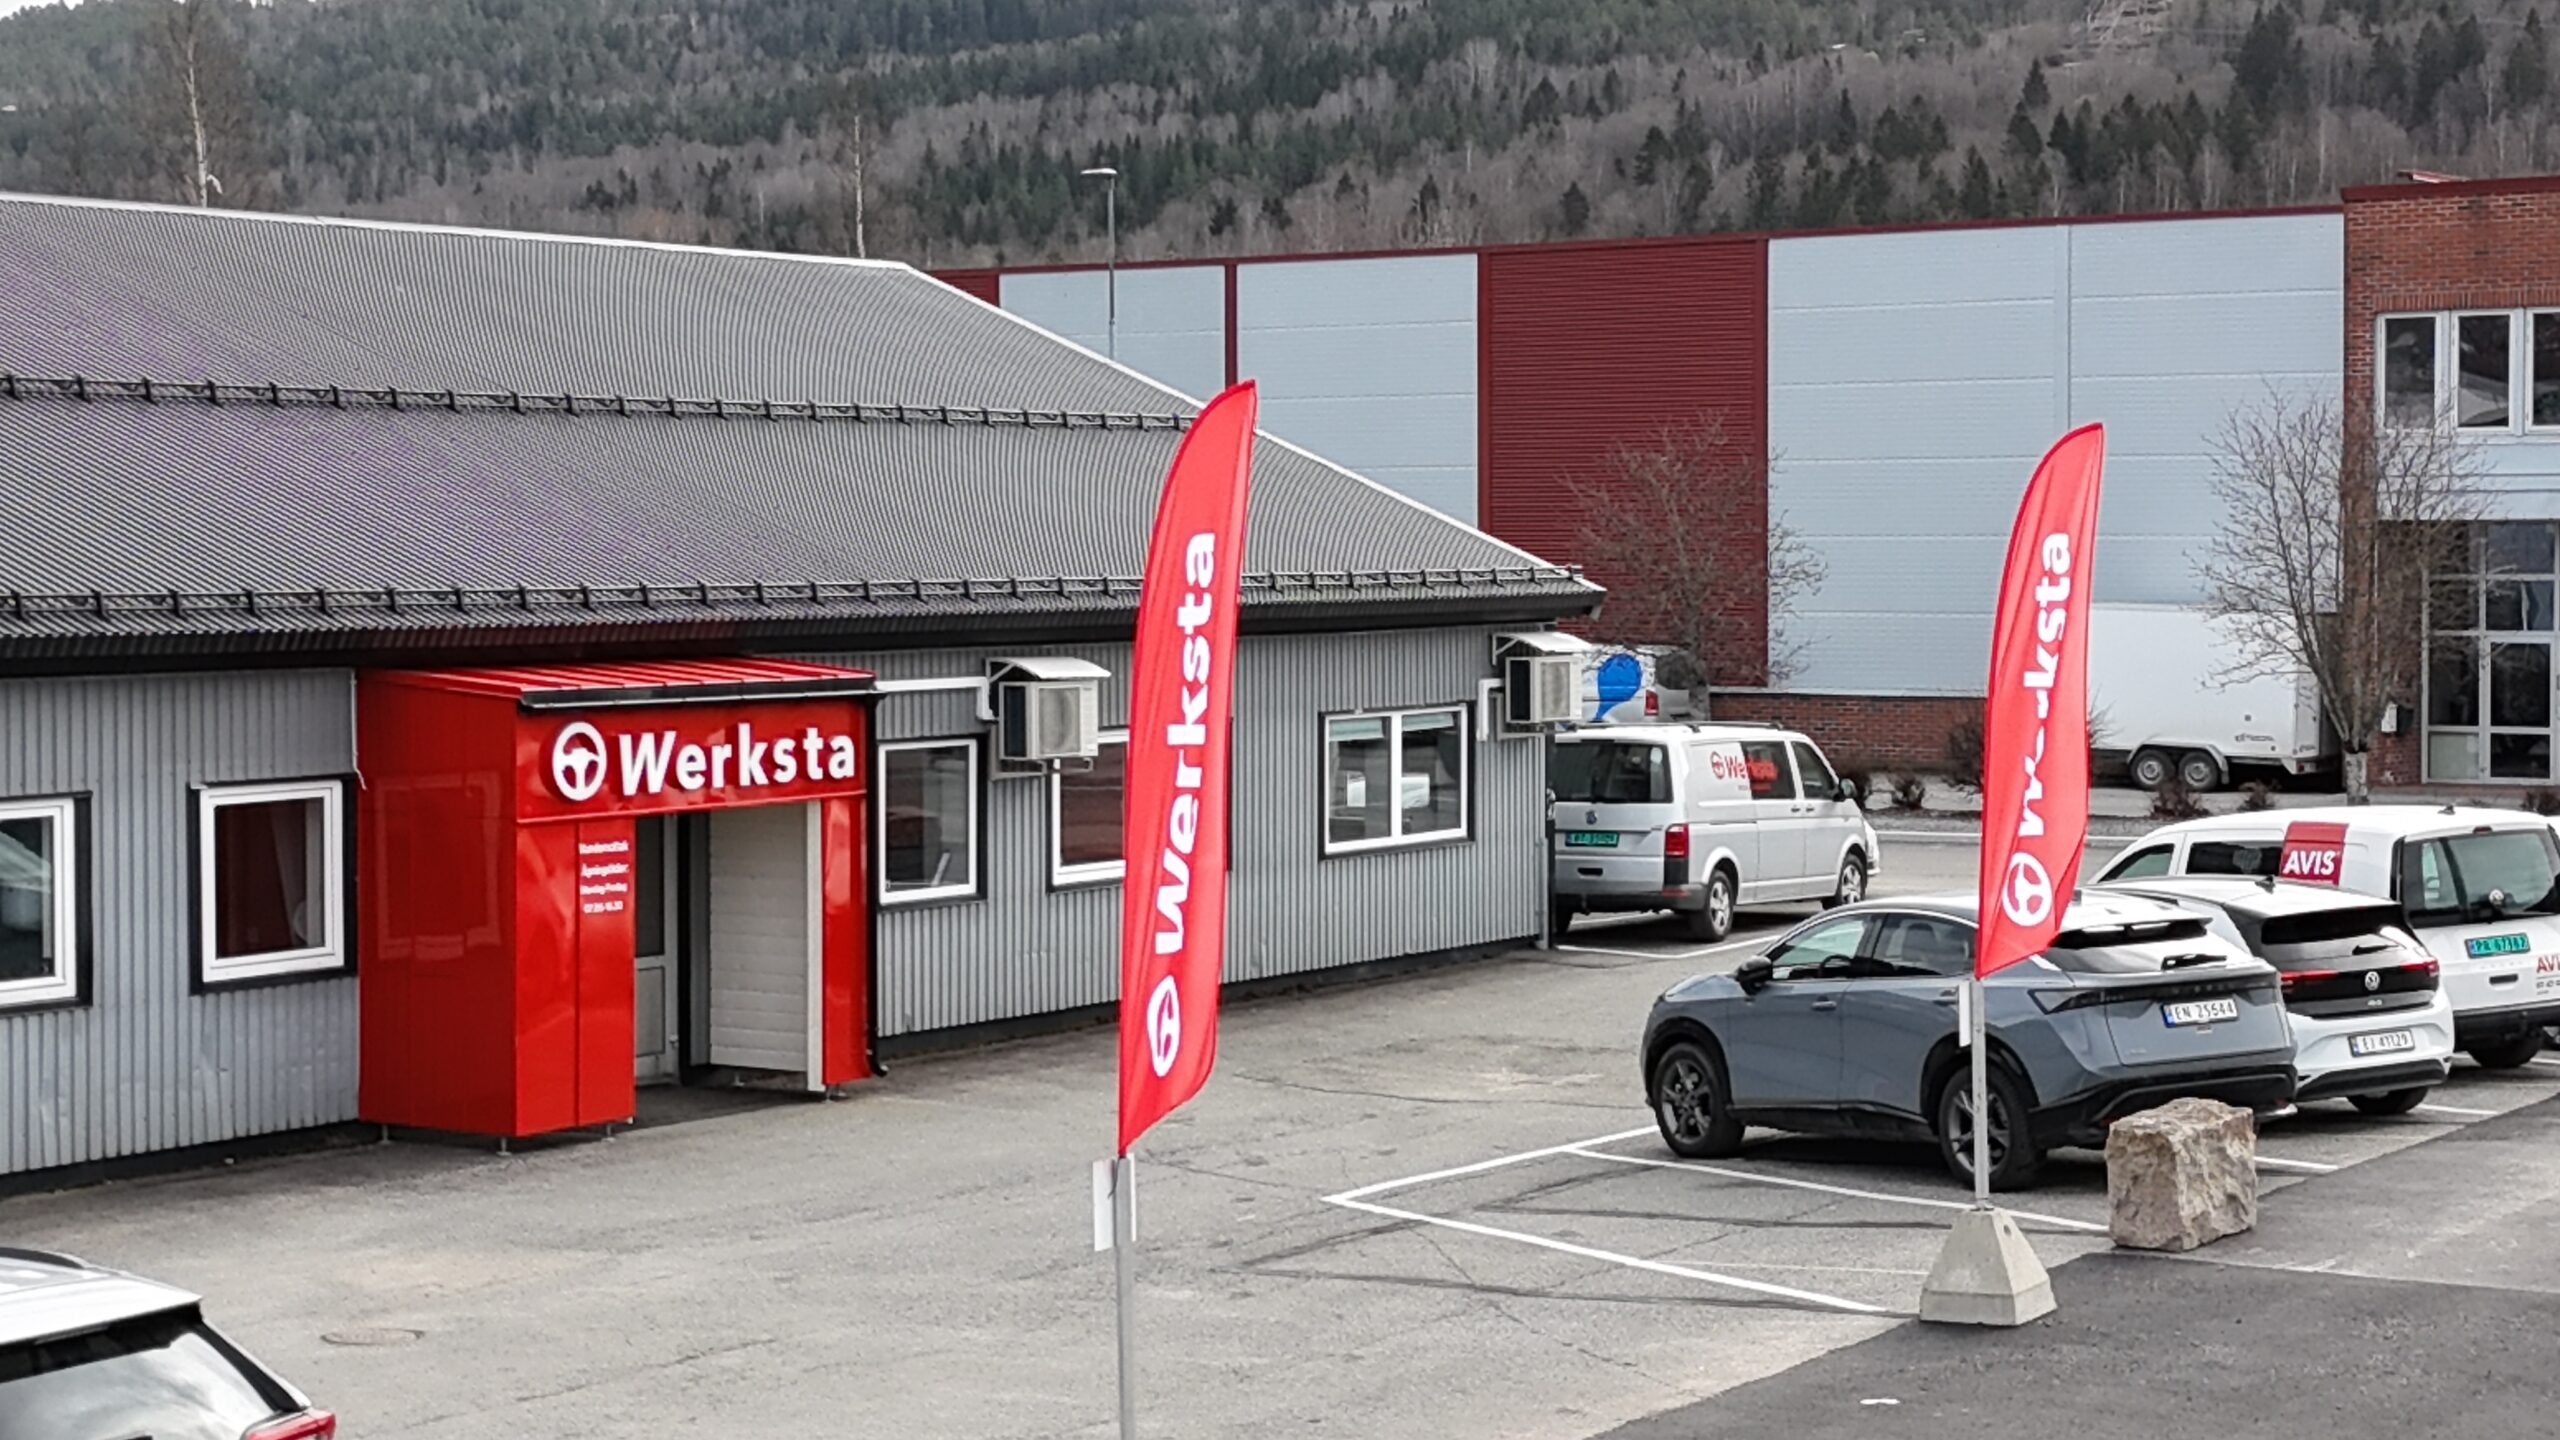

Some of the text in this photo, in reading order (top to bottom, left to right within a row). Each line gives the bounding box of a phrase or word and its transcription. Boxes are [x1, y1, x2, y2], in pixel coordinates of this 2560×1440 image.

[619, 723, 855, 796] Werksta
[1155, 533, 1215, 954] Werksta
[2282, 850, 2336, 875] AVIS
